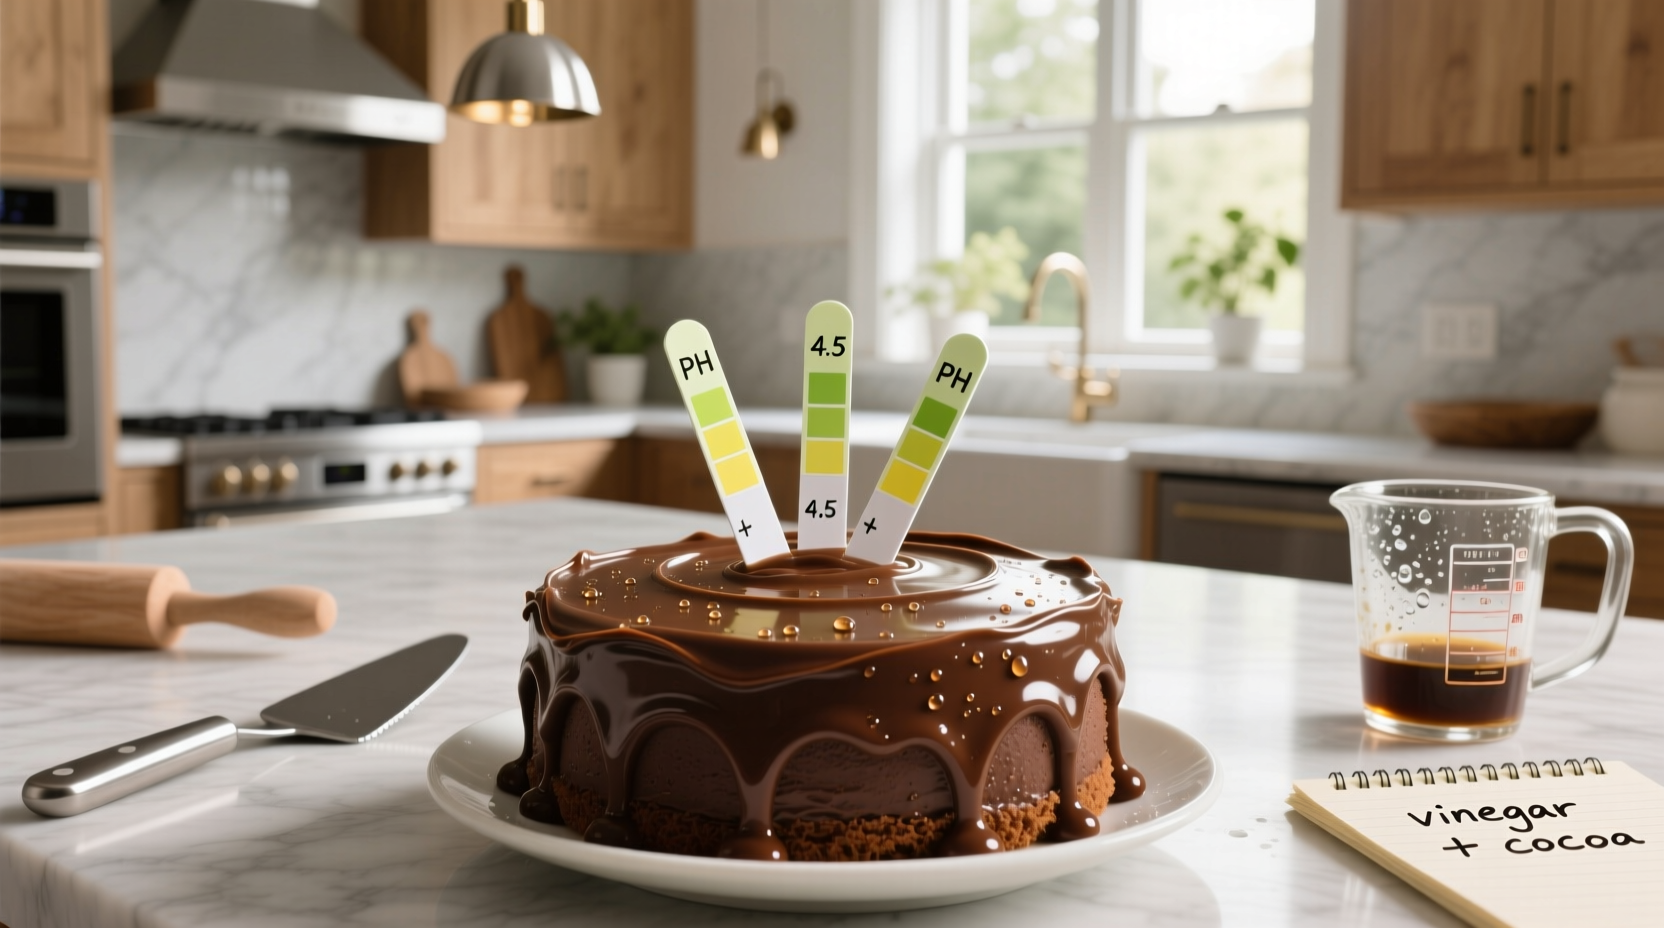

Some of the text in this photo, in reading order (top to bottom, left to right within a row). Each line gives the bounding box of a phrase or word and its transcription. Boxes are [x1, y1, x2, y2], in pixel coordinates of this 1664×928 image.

[810, 335, 847, 357] 4.5
[678, 349, 715, 381] PH
[935, 361, 973, 394] PH
[804, 499, 837, 519] 4.5
[1407, 802, 1577, 833] vinegar
[1442, 832, 1646, 858] + cocoa
